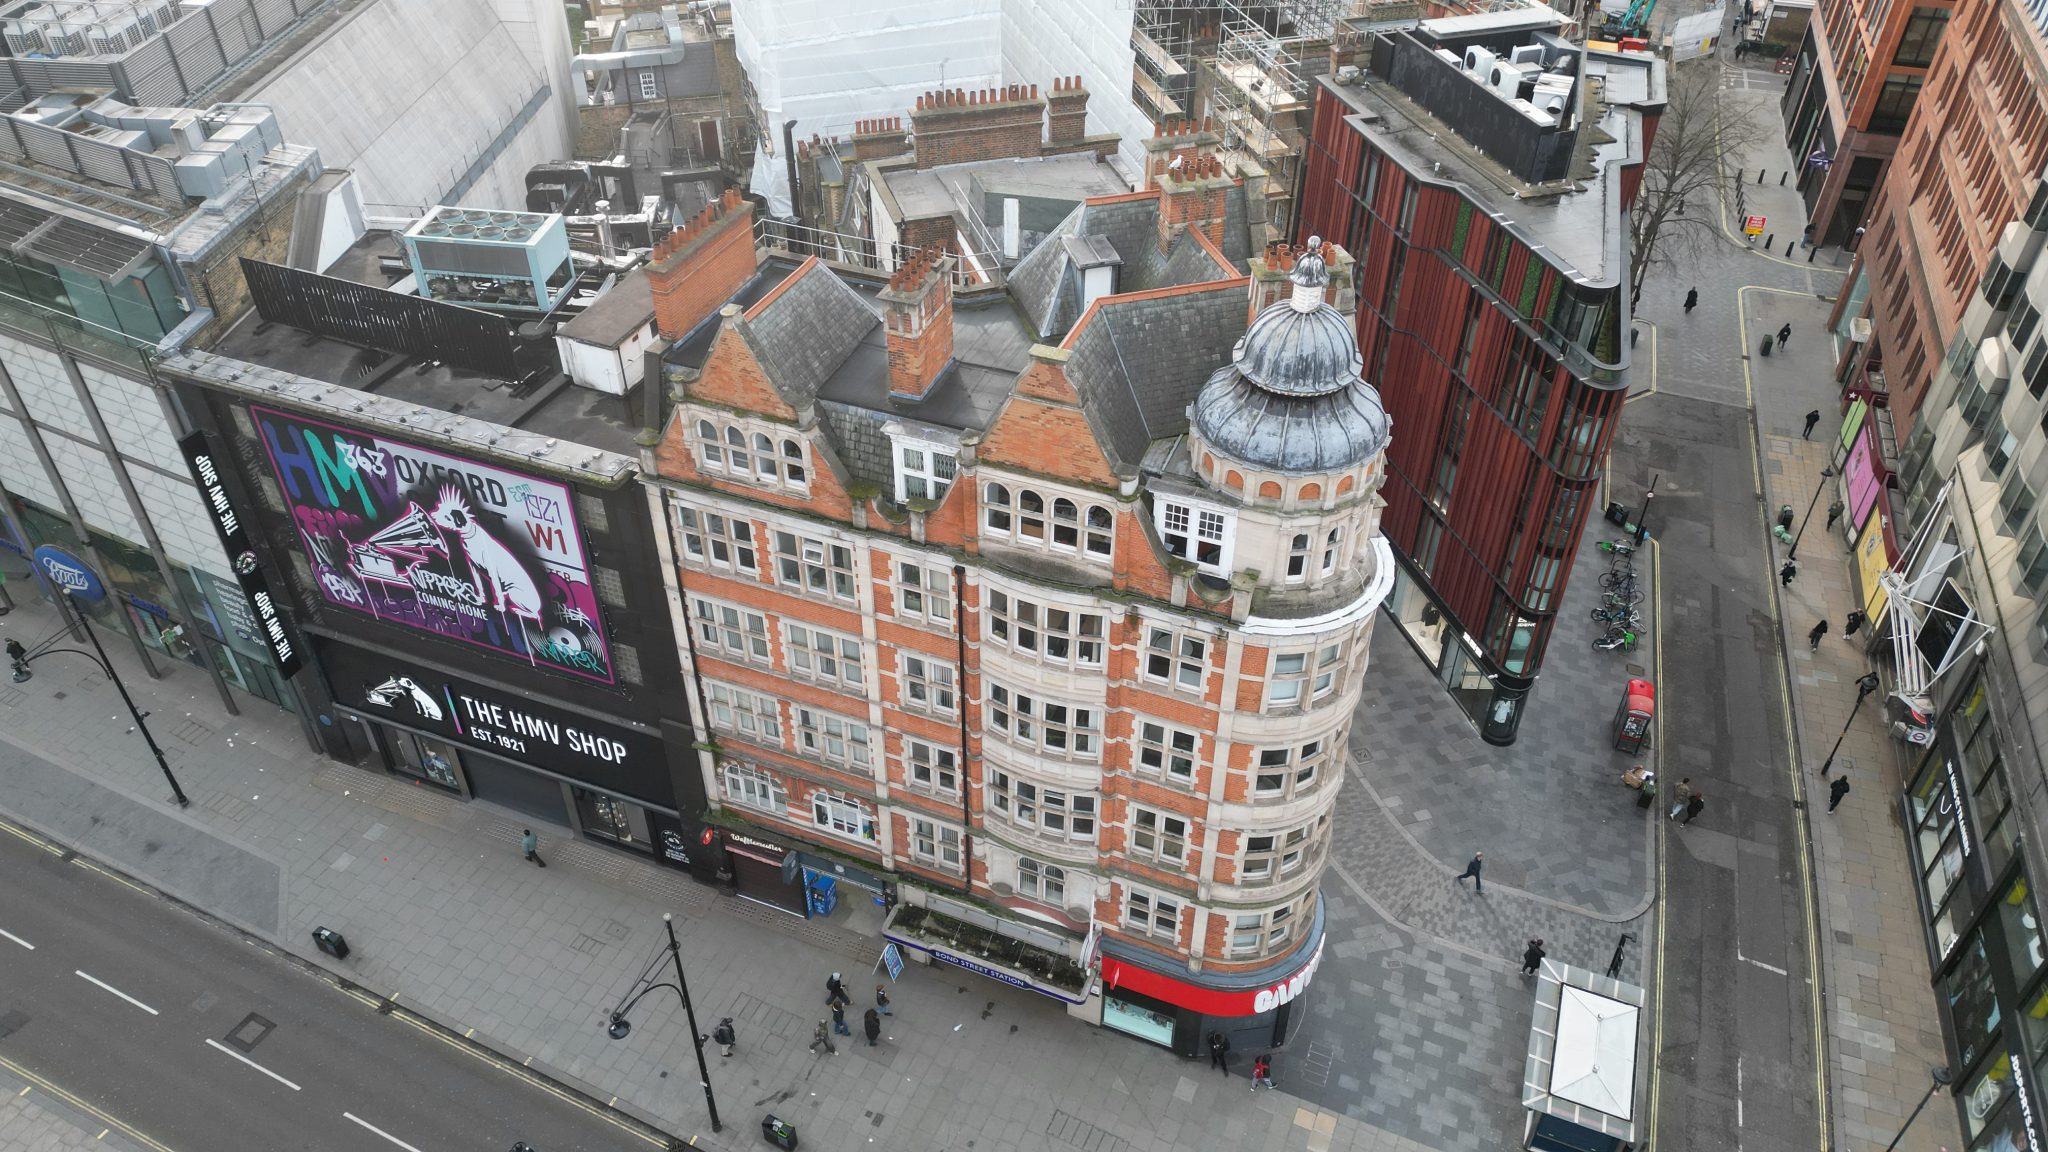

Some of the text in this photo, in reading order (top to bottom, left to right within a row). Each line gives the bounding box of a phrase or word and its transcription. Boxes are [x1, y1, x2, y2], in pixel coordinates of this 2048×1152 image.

[195, 455, 239, 536] THE HMV SHOP
[393, 454, 508, 508] OXFORD
[521, 492, 563, 526] 1921
[524, 519, 568, 555] W1
[43, 556, 88, 590] Boots
[254, 591, 275, 620] SHOP
[416, 590, 456, 612] COMING
[457, 600, 489, 621] HOME
[266, 617, 285, 643] HMV
[275, 638, 293, 663] THE
[460, 696, 627, 765] THE HMV SHOP
[935, 951, 1025, 986] BOND STREET STATION
